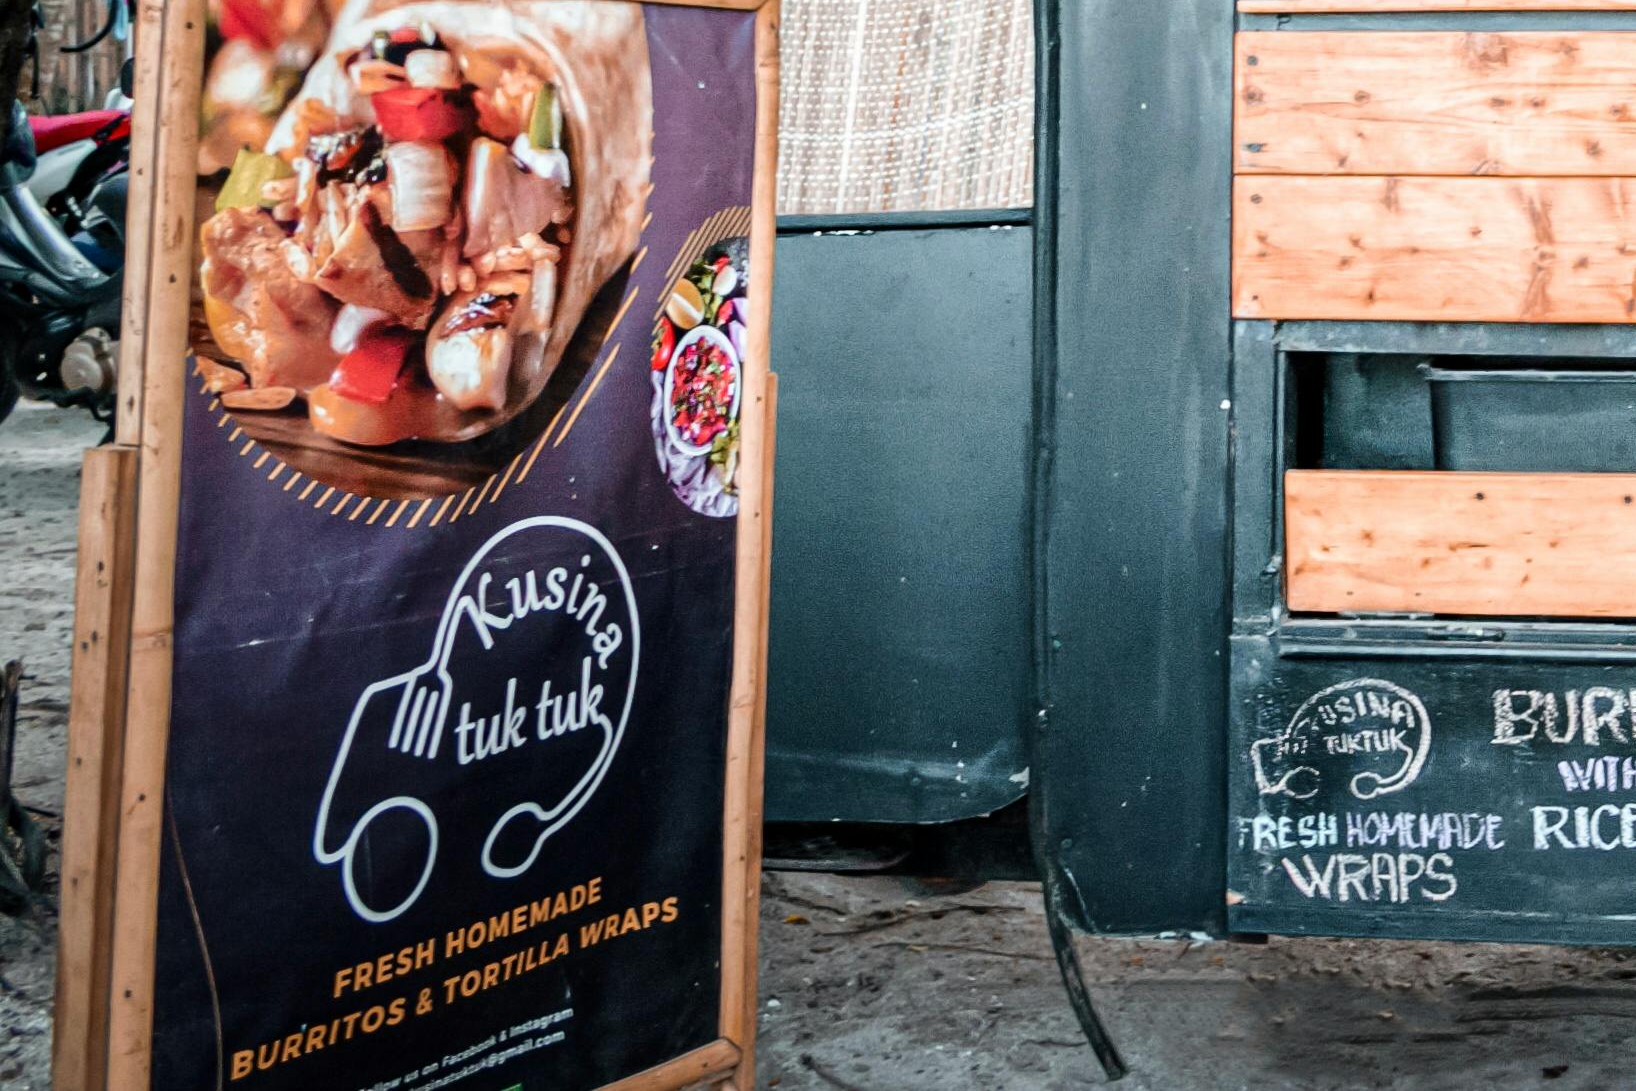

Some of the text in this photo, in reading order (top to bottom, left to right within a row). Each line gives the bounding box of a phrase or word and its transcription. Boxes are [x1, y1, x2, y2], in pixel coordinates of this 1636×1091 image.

[463, 554, 623, 670] Kusina
[454, 656, 604, 766] tuk tuk
[1239, 811, 1505, 853] FRESH HOMEMADE
[1281, 852, 1458, 904] WRAPS
[229, 895, 681, 1082] BURRITOS & TORTILLA WRAPS
[333, 876, 603, 1000] FRESH HOMEMADE
[441, 1035, 497, 1067] Facebook
[509, 1007, 574, 1038] Instagram
